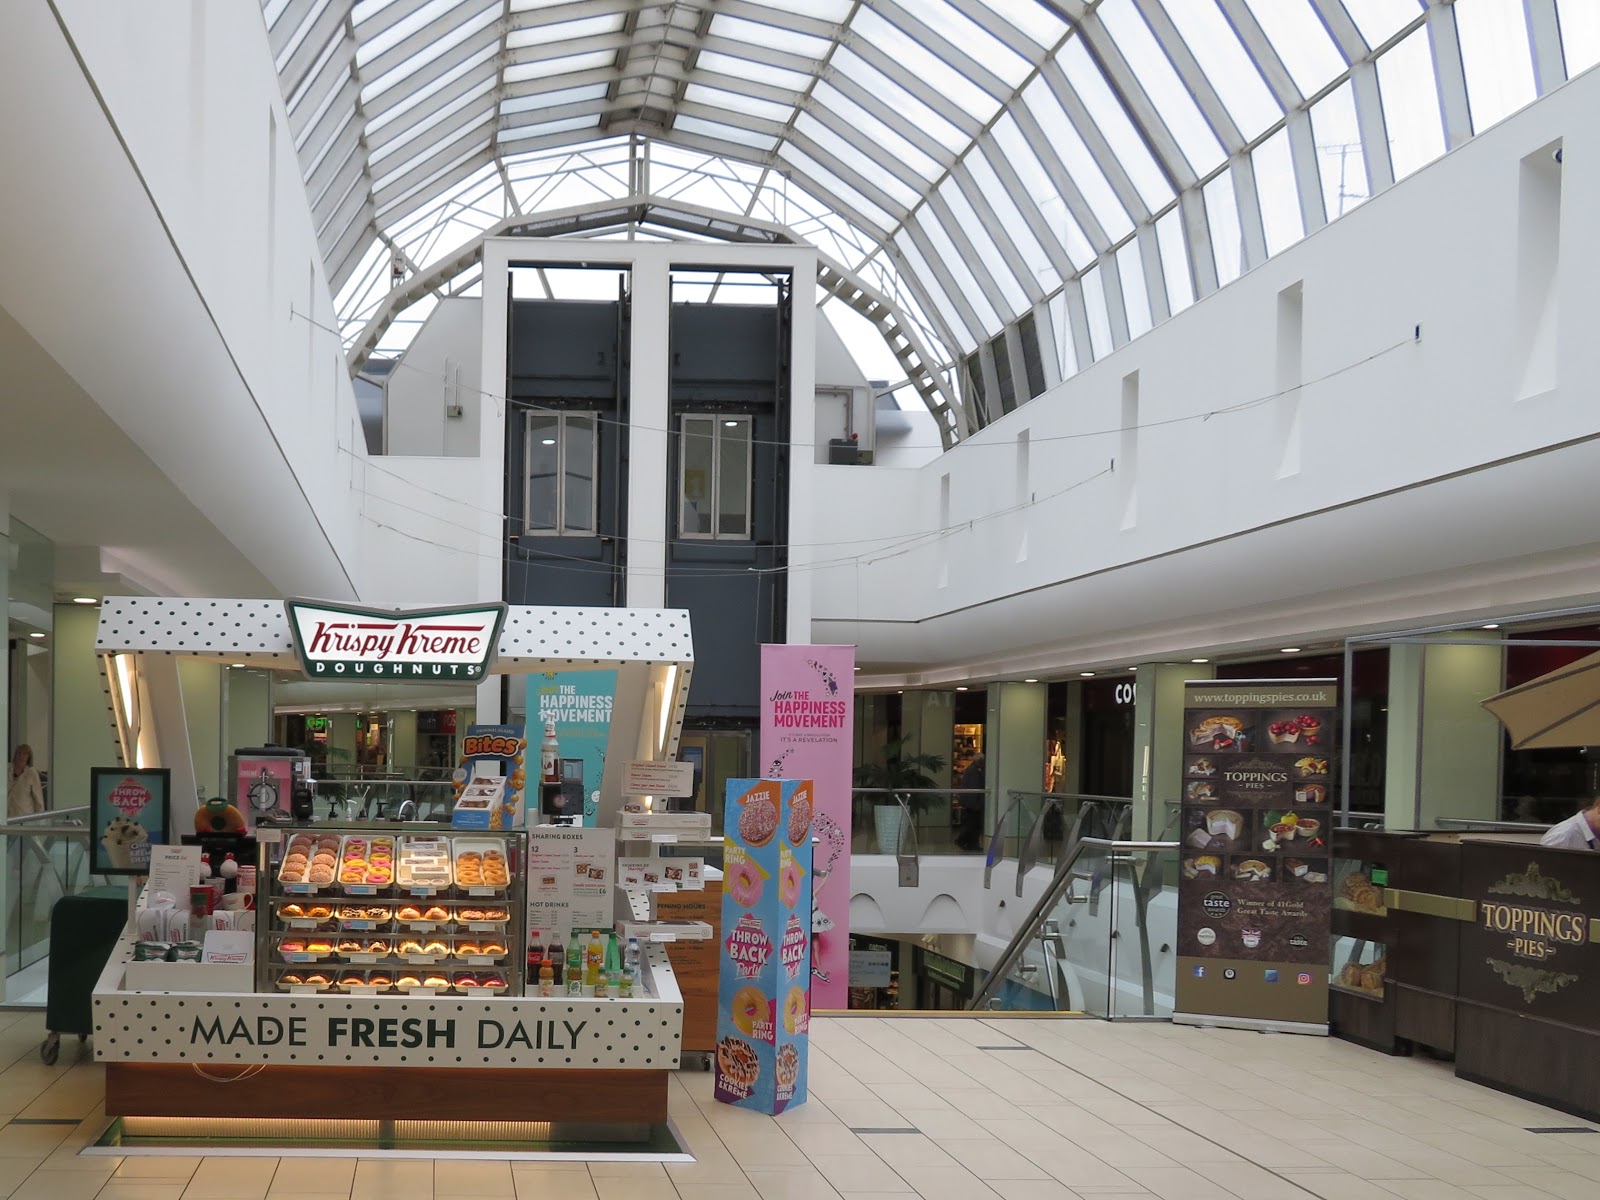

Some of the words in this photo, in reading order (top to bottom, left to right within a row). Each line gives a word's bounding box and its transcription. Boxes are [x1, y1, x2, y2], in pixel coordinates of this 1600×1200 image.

[308, 621, 398, 659] Krispy
[396, 623, 486, 655] Kreme
[560, 684, 576, 695] THE
[770, 690, 793, 701] Join
[794, 691, 809, 700] THE
[540, 694, 613, 709] HAPPINESS
[1194, 691, 1327, 704] www.toppingspies.co.uk
[774, 701, 846, 714] HAPPINESS
[540, 708, 612, 723] MOVEMENT
[774, 714, 846, 728] MOVEMENT
[464, 735, 519, 756] Bites
[1224, 771, 1288, 782] TOPPINGS
[114, 788, 147, 796] THROW
[746, 790, 770, 804] JAZZIE
[793, 790, 807, 805] JAZZIE
[113, 796, 147, 807] BACK
[725, 846, 746, 855] PARTY
[725, 855, 746, 865] RING
[1203, 899, 1230, 907] taste
[1237, 899, 1264, 907] Winner
[1237, 907, 1257, 915] Great
[1259, 908, 1279, 916] Taste
[1481, 902, 1584, 942] TOPPINGS
[731, 929, 768, 946] THROW
[783, 930, 805, 946] THROW
[730, 943, 768, 965] BACK
[782, 944, 804, 965] BACK
[1514, 938, 1545, 958] PIES
[736, 962, 763, 978] Party
[794, 1013, 808, 1025] PARTY
[190, 1014, 307, 1047] MADE
[328, 1017, 455, 1048] FRESH
[477, 1019, 588, 1050] DAILY
[752, 1021, 774, 1031] PARTY
[794, 1022, 808, 1035] RING
[752, 1029, 774, 1041] RING
[719, 1073, 748, 1092] COOKIES
[777, 1084, 793, 1092] COOKIES
[718, 1081, 748, 1100] &KREME
